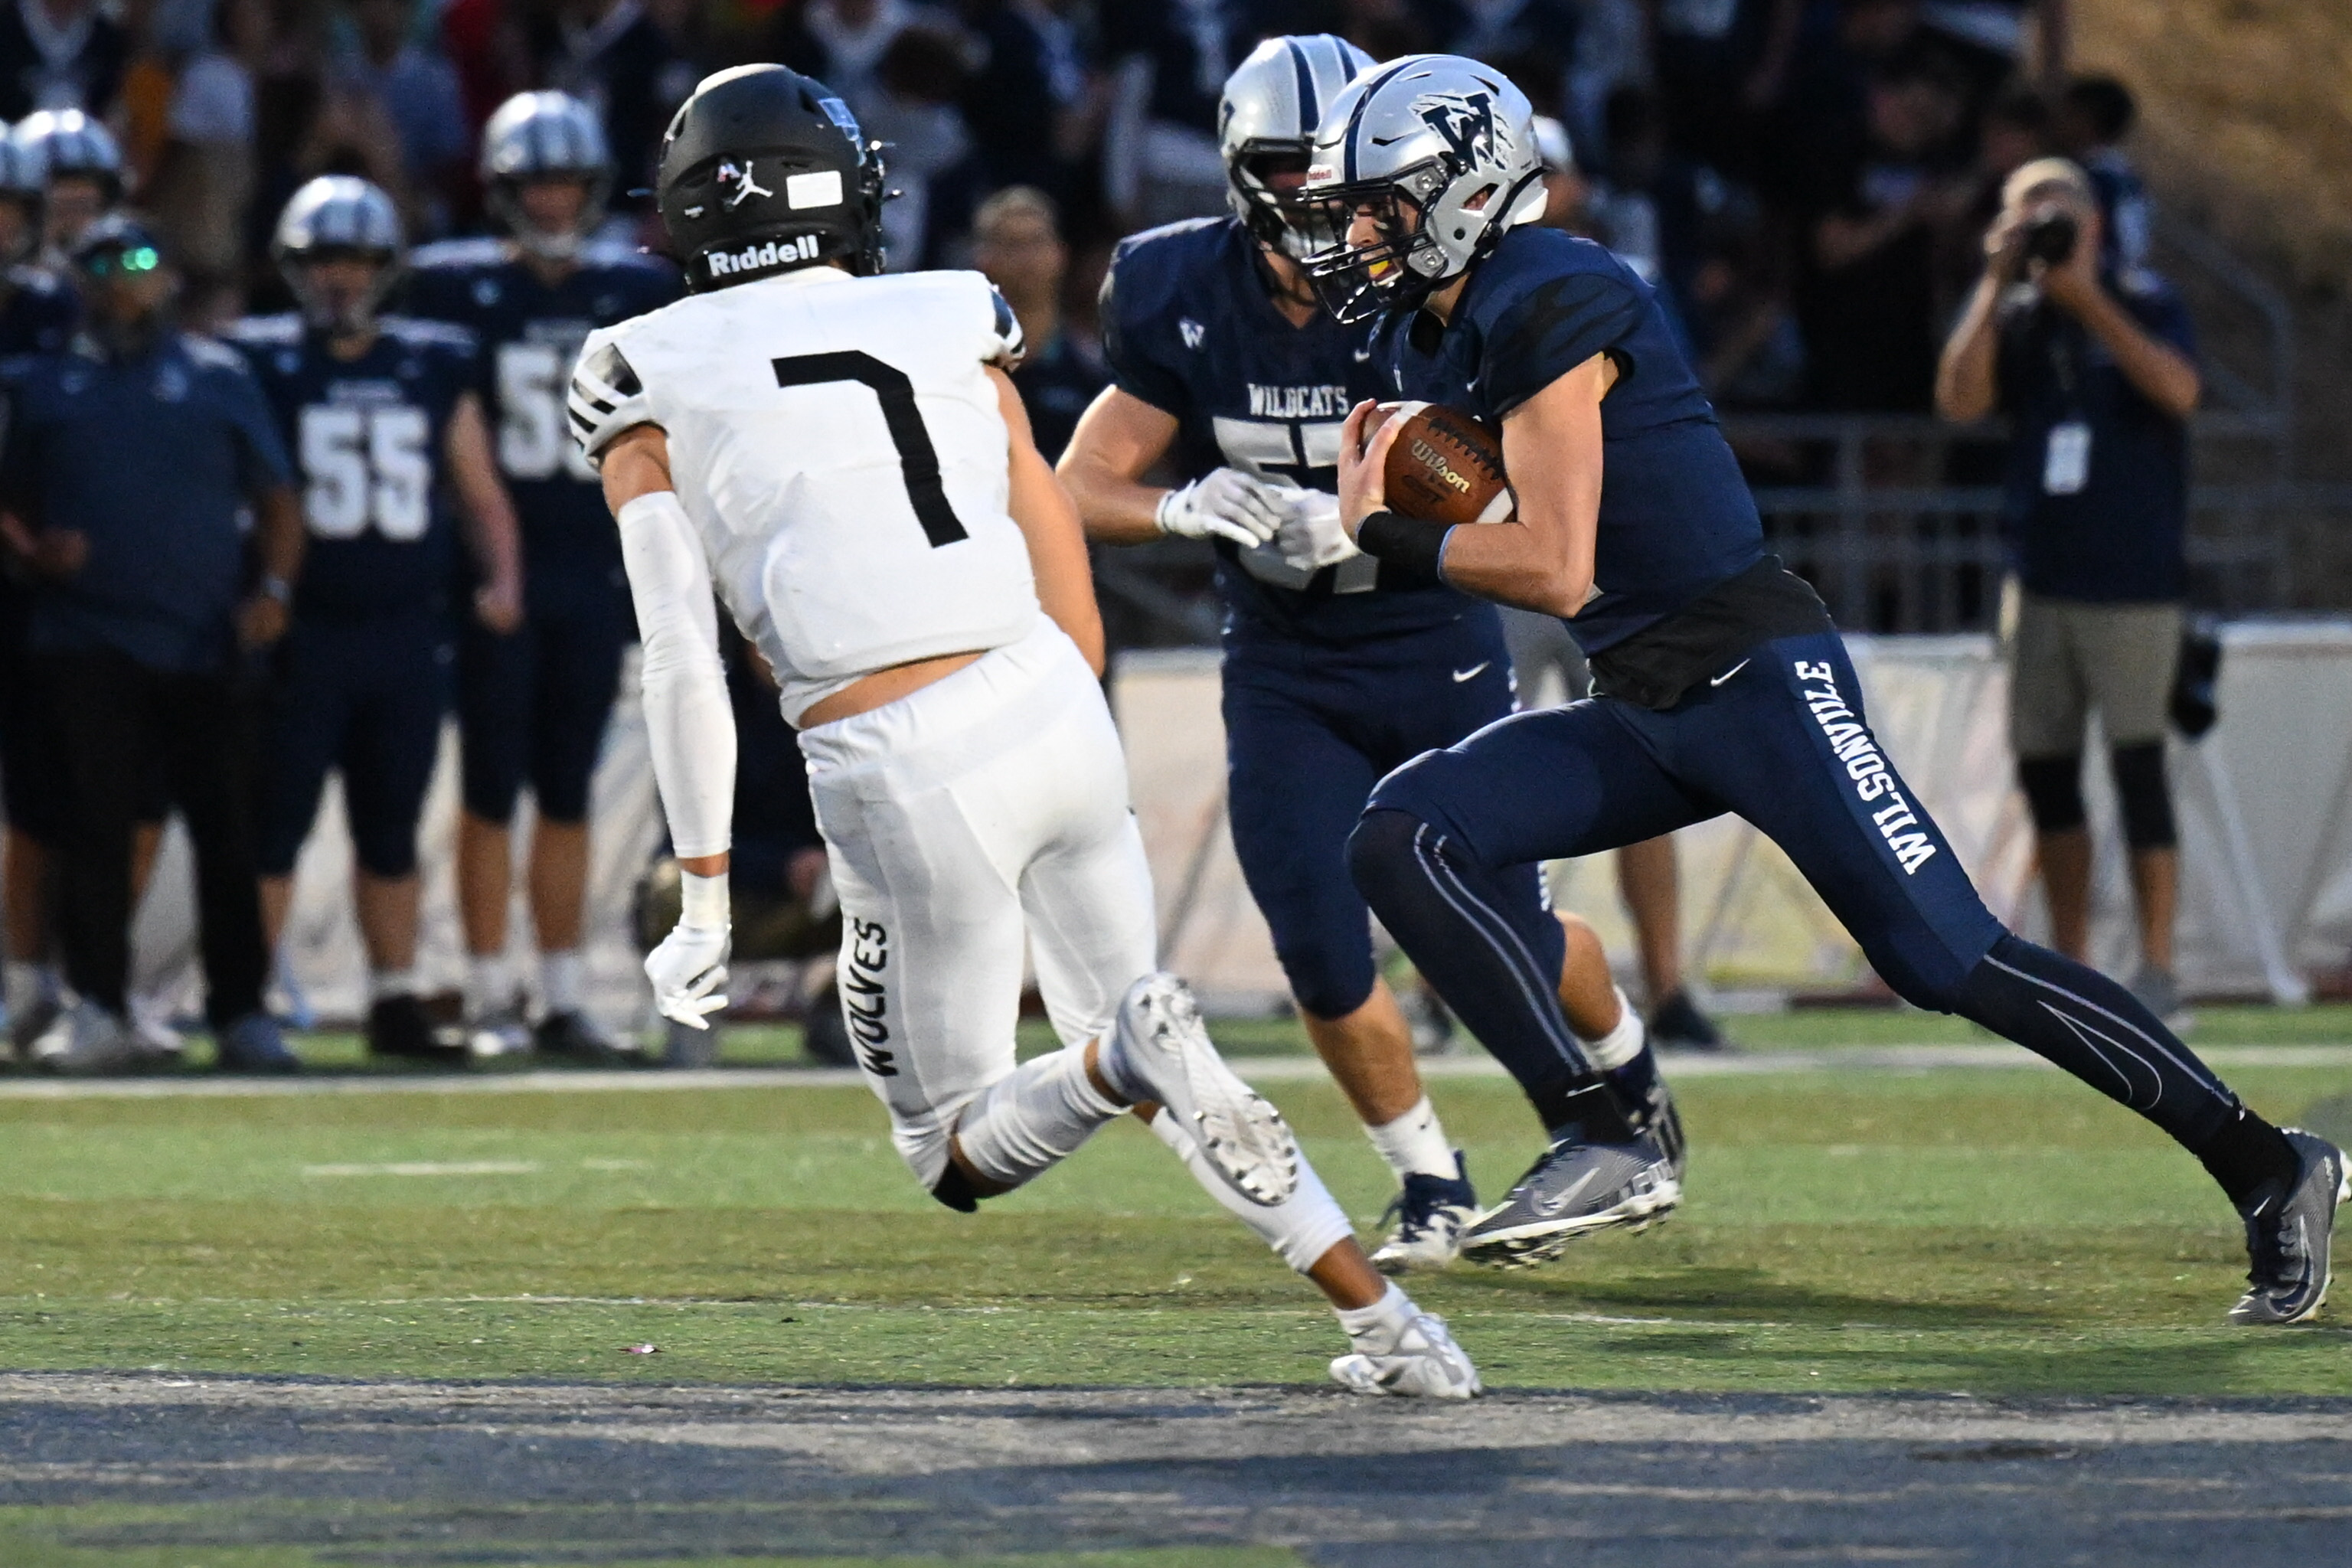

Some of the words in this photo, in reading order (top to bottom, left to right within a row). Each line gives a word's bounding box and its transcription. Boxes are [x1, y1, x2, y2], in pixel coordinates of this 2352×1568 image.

[707, 234, 820, 277] Riddell
[770, 349, 970, 549] 7
[1247, 383, 1351, 419] WILDCATS
[1411, 438, 1472, 494] Wilson
[299, 403, 431, 540] 55
[1795, 661, 1936, 876] WILSONVILLE
[845, 916, 899, 1077] WOLVES
